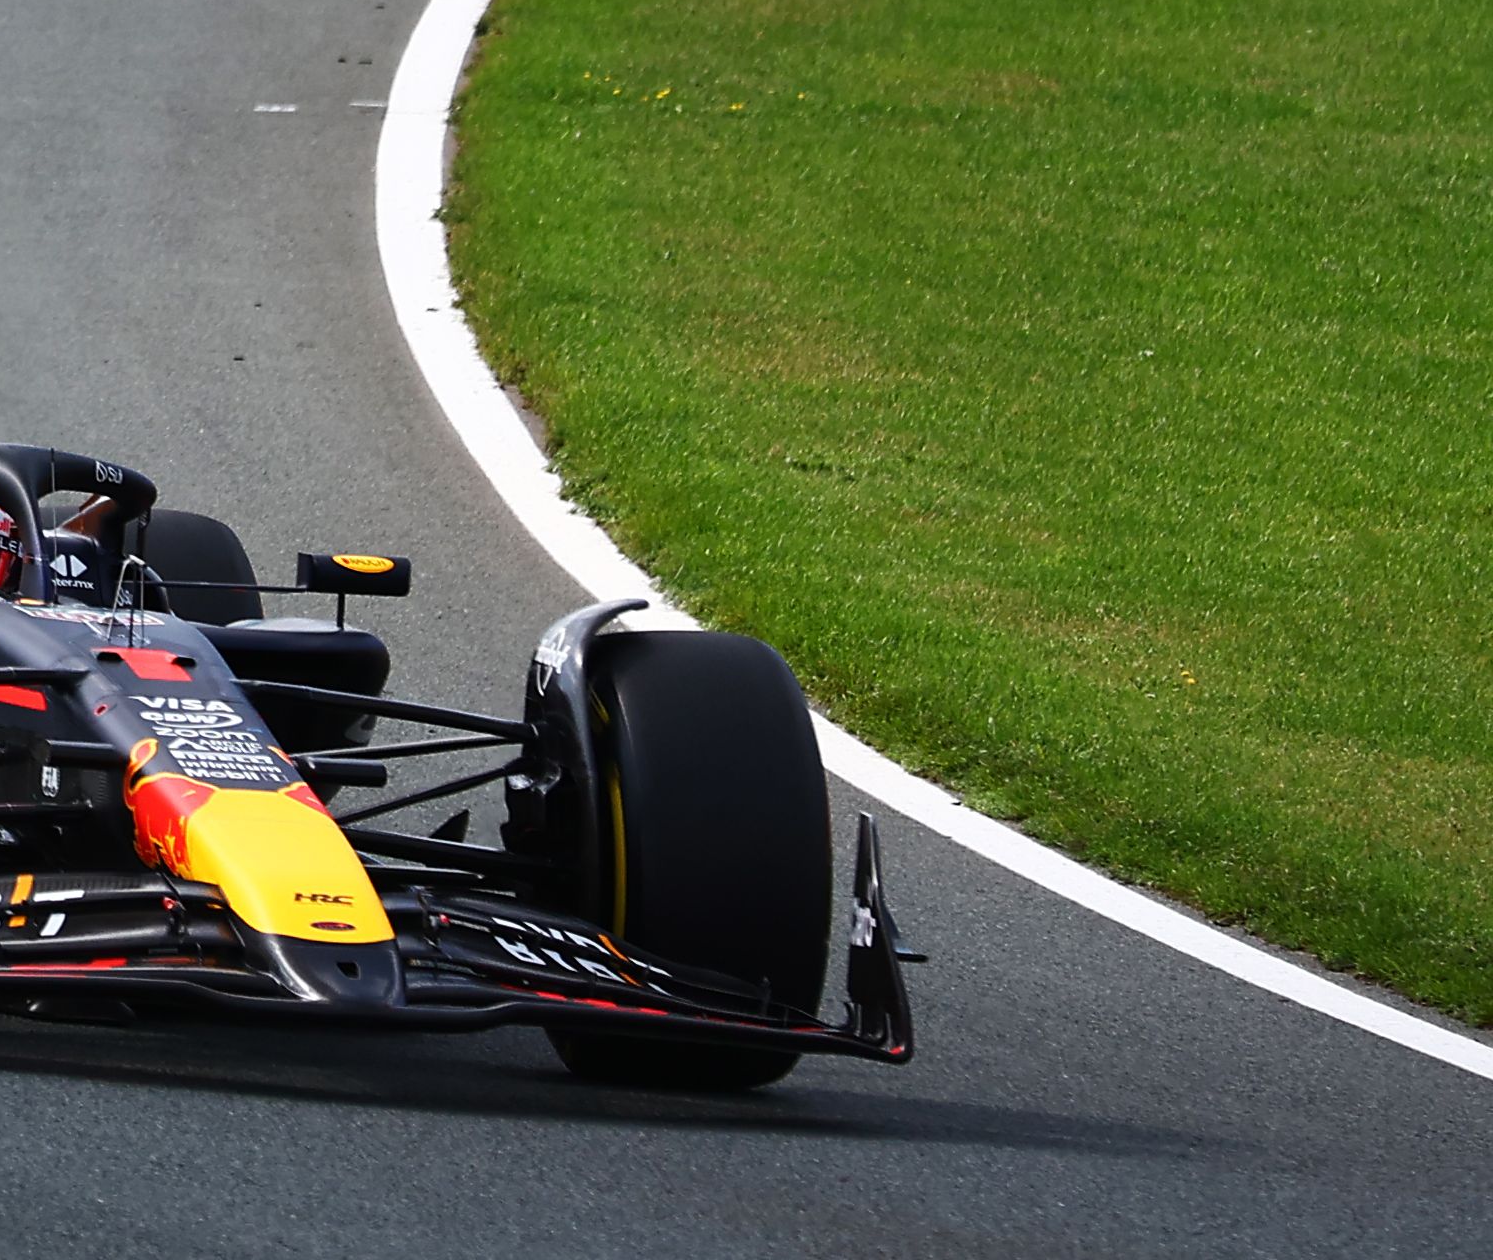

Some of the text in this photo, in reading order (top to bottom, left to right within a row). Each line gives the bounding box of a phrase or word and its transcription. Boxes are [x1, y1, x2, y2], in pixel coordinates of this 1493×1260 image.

[128, 696, 235, 713] VISA
[152, 726, 257, 742] zoom
[183, 768, 260, 781] Mobil
[294, 893, 354, 906] HRC
